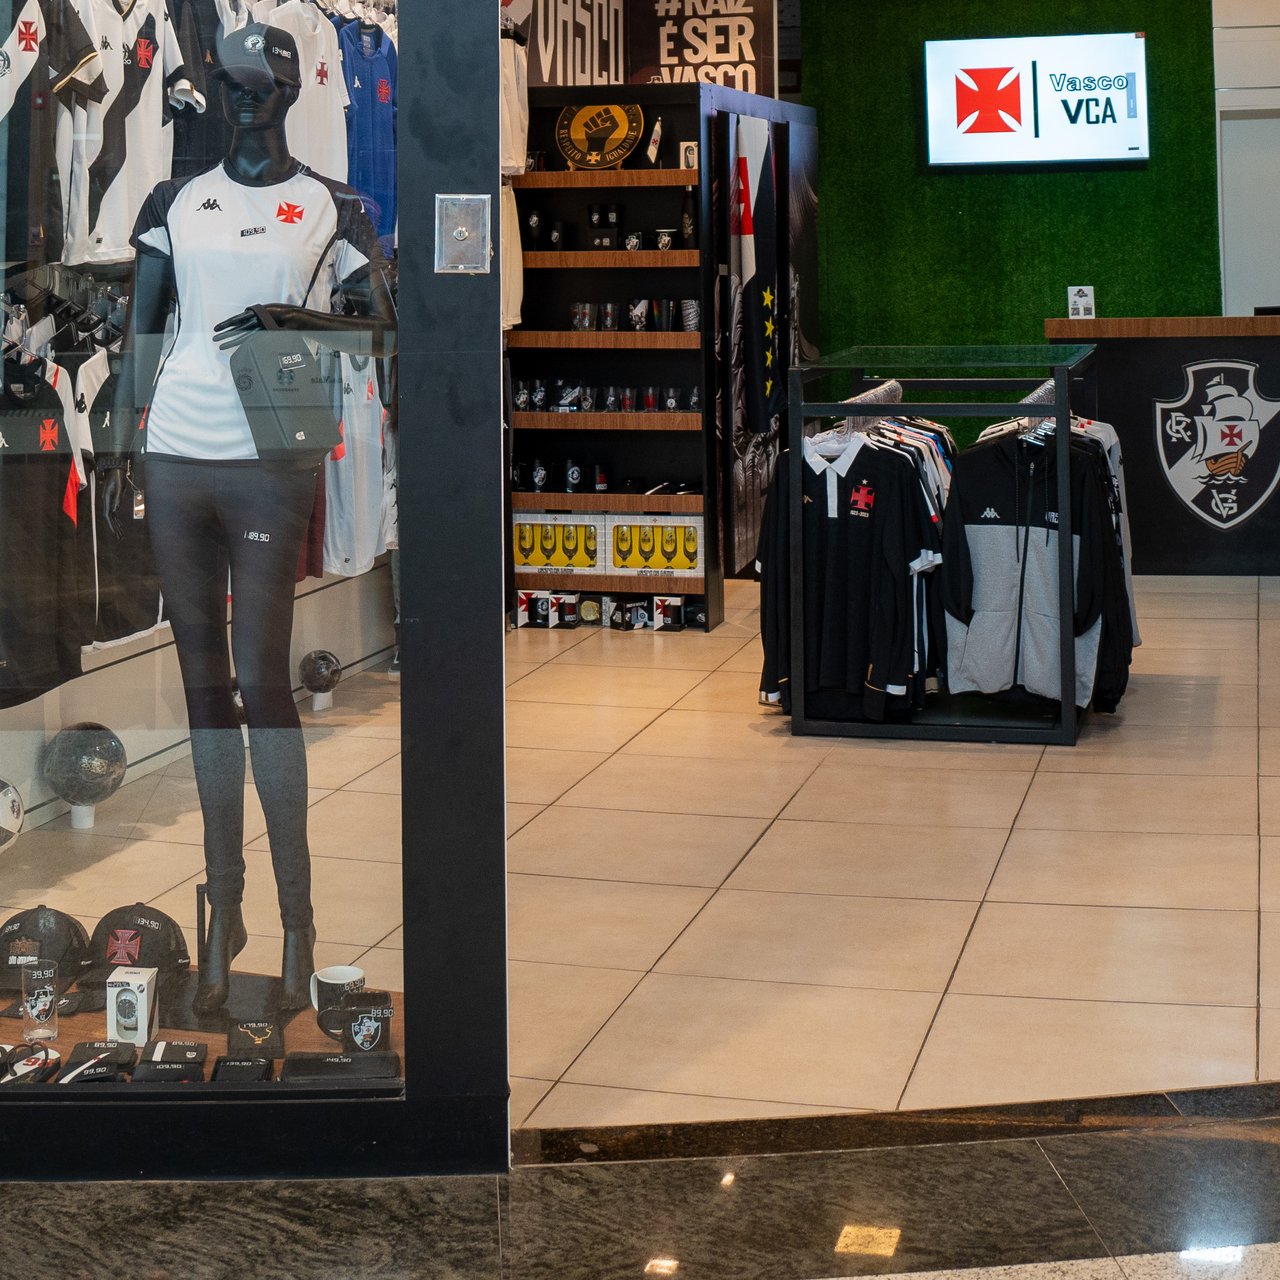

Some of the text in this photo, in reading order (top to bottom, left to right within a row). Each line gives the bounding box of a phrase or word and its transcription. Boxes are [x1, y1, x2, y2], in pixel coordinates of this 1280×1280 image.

[660, 16, 755, 66] É SER
[1049, 71, 1129, 92] Vasco
[1061, 97, 1117, 125] VCA
[560, 129, 582, 160] RESPEITO
[606, 131, 638, 161] IGUALDADE
